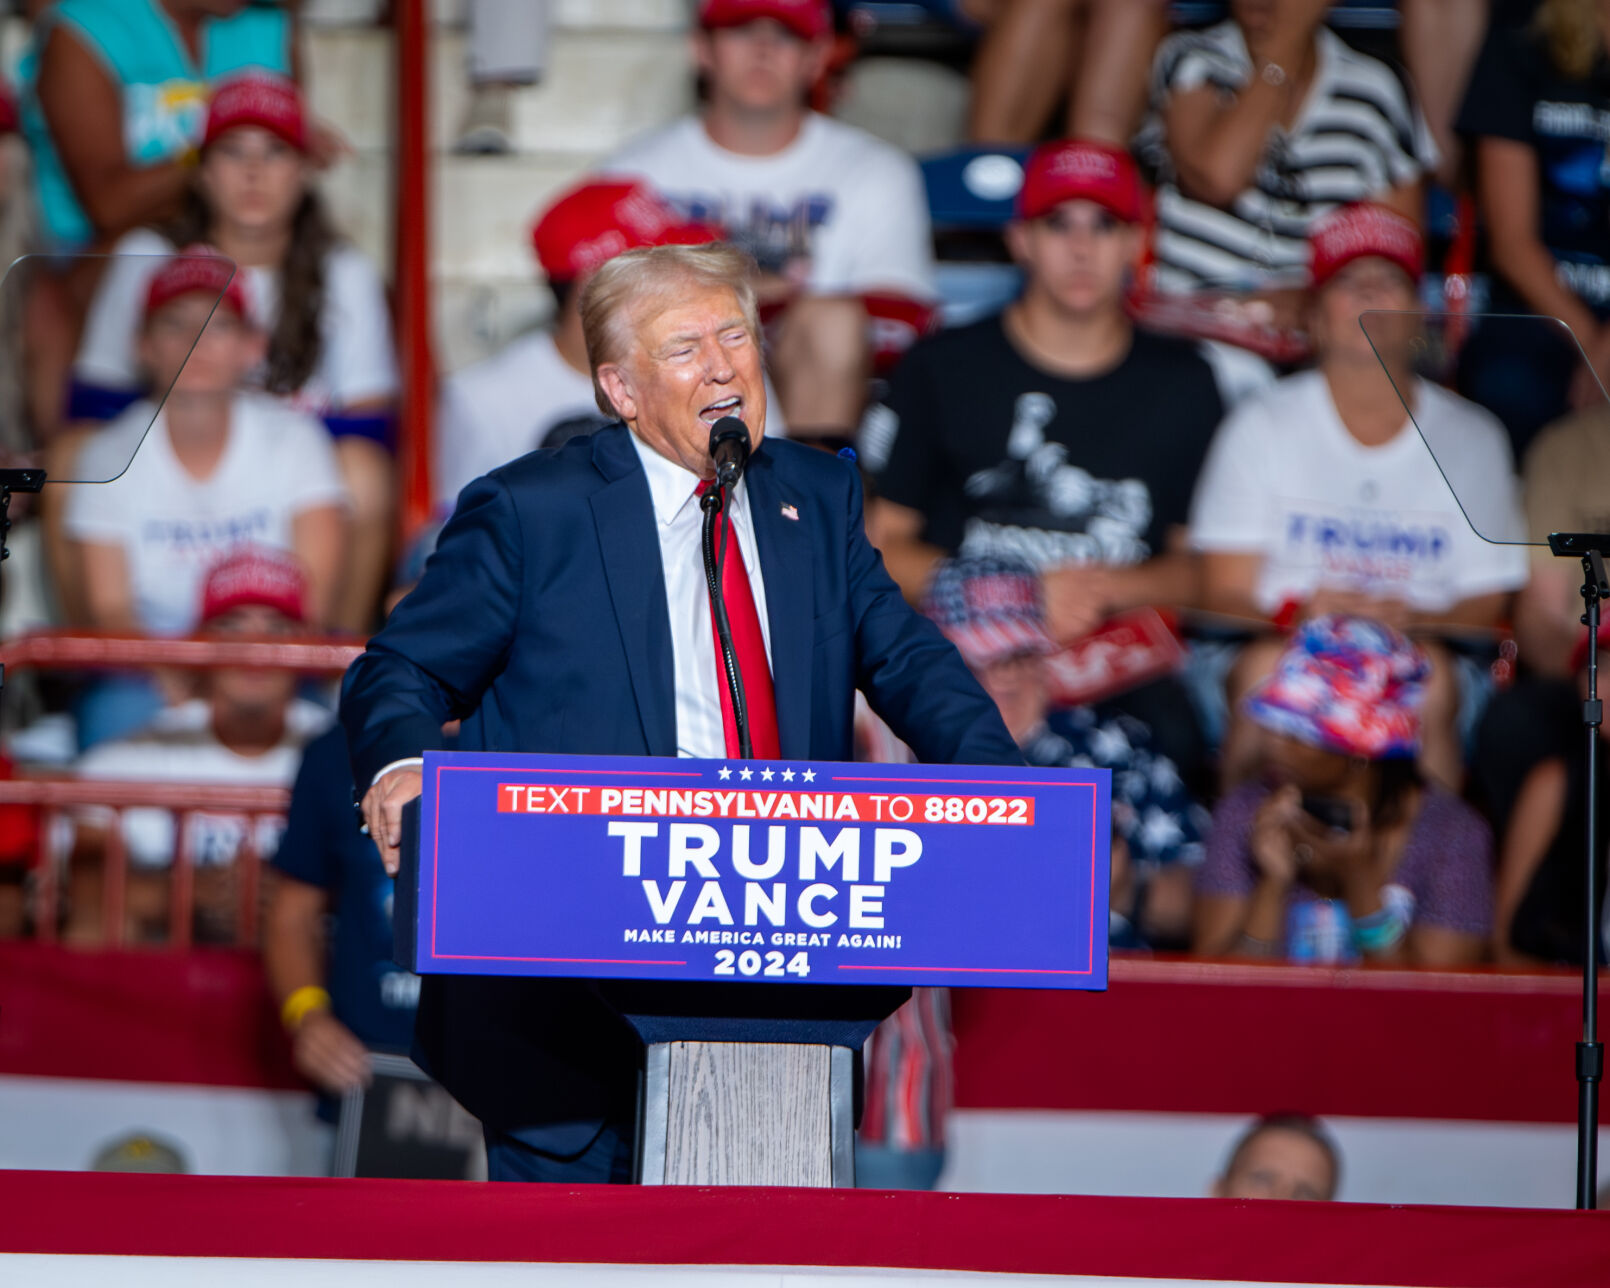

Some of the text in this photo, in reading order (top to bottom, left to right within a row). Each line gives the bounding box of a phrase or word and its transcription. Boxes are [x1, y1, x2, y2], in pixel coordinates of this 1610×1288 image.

[1286, 514, 1452, 560] TRUMP
[505, 785, 1028, 824] TEXT PENNSYLVANIA TO 88022
[607, 820, 923, 883] TRUMP
[641, 879, 886, 929] VANCE
[624, 928, 902, 949] MAKE AMERICA GREAT AGAIN!
[713, 949, 811, 977] 2024
